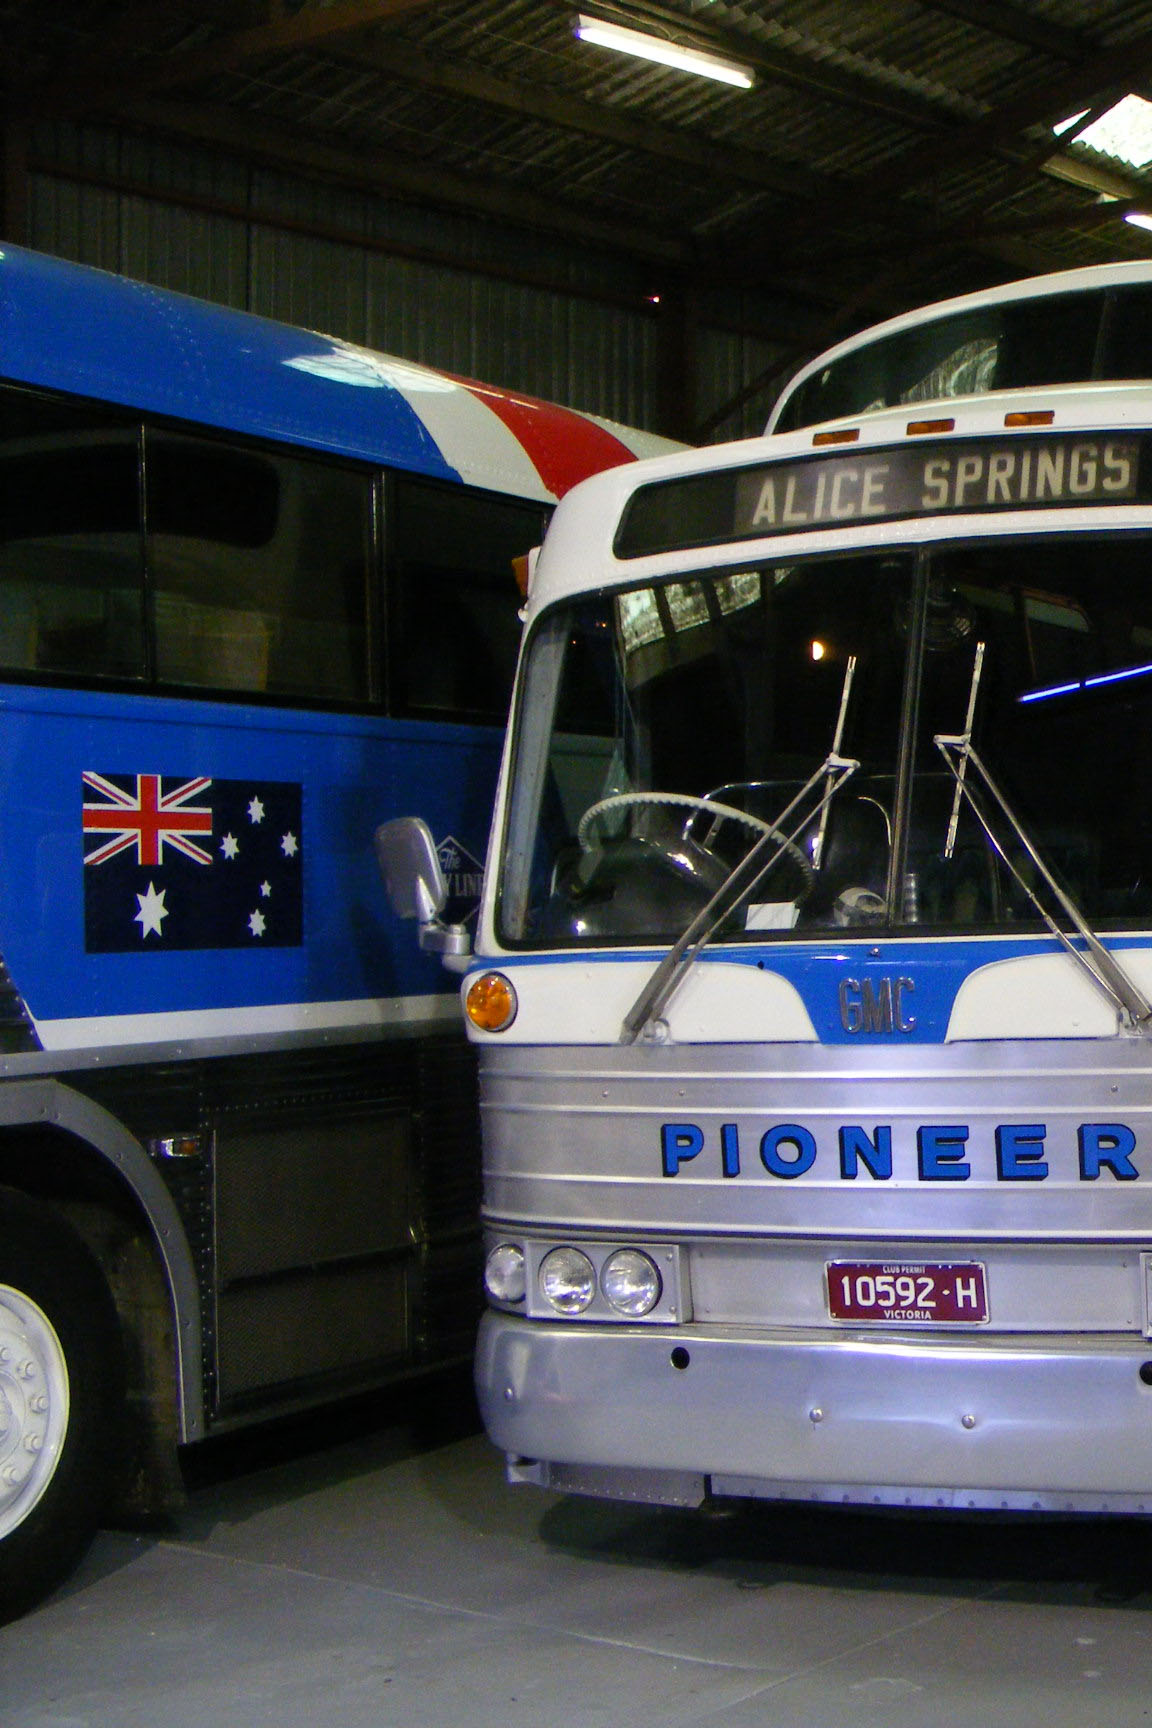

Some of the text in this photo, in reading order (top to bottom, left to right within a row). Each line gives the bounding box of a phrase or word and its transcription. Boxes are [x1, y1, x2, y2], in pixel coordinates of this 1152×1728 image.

[754, 444, 1131, 524] ALICE SPRINGS
[839, 976, 916, 1033] GMC
[660, 1123, 1140, 1181] PIONEER
[882, 1265, 926, 1274] CLUB PERMIT
[883, 1310, 932, 1320] VICTORIA
